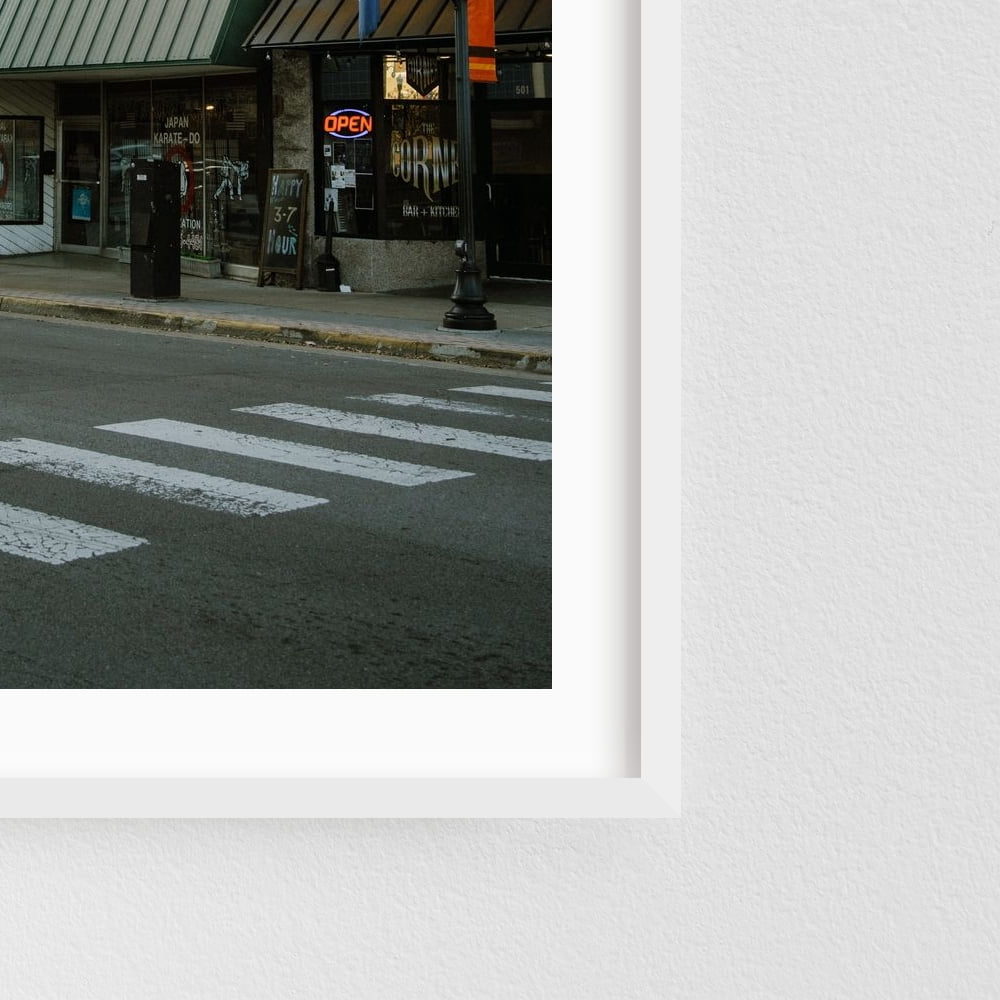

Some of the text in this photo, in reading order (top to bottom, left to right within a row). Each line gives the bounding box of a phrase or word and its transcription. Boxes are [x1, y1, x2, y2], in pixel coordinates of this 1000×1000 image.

[515, 85, 529, 95] 501
[164, 116, 189, 129] JAPAN
[324, 115, 373, 133] OPEN
[392, 135, 459, 202] CORNE
[271, 175, 303, 198] HAPPY
[402, 204, 419, 217] BAR
[267, 229, 297, 255] HOUR
